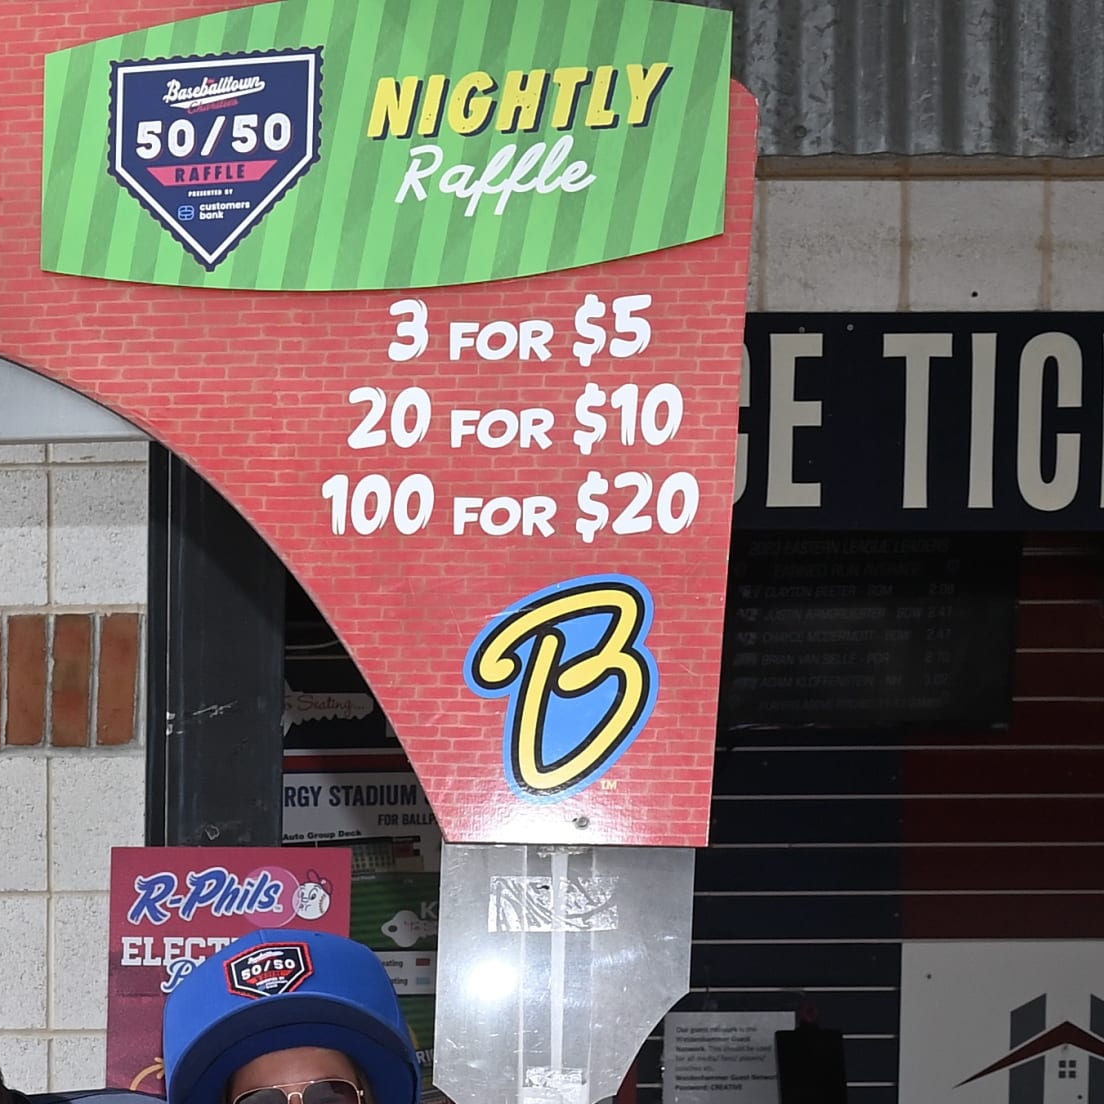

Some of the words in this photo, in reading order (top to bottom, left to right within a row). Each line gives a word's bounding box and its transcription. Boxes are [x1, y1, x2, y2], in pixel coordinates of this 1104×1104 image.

[367, 62, 673, 140] NIGHTLY
[135, 112, 293, 160] 50/50
[174, 163, 246, 184] RAFFLE
[395, 134, 597, 217] Raffle
[199, 201, 251, 212] customers
[199, 210, 224, 220] bank
[388, 299, 430, 362] 3
[449, 320, 555, 363] FOR
[572, 293, 652, 367] $5
[347, 387, 432, 450] 20
[450, 408, 556, 450] FOR
[573, 382, 685, 455] $10
[882, 331, 1104, 513] TIC
[322, 473, 435, 536] 100
[453, 496, 558, 538] FOR
[576, 471, 700, 544] $20
[329, 784, 417, 807] STADIUM
[307, 831, 336, 840] Group
[128, 865, 284, 927] R-Phils
[121, 936, 240, 967] ELECT
[241, 958, 296, 981] 50/50
